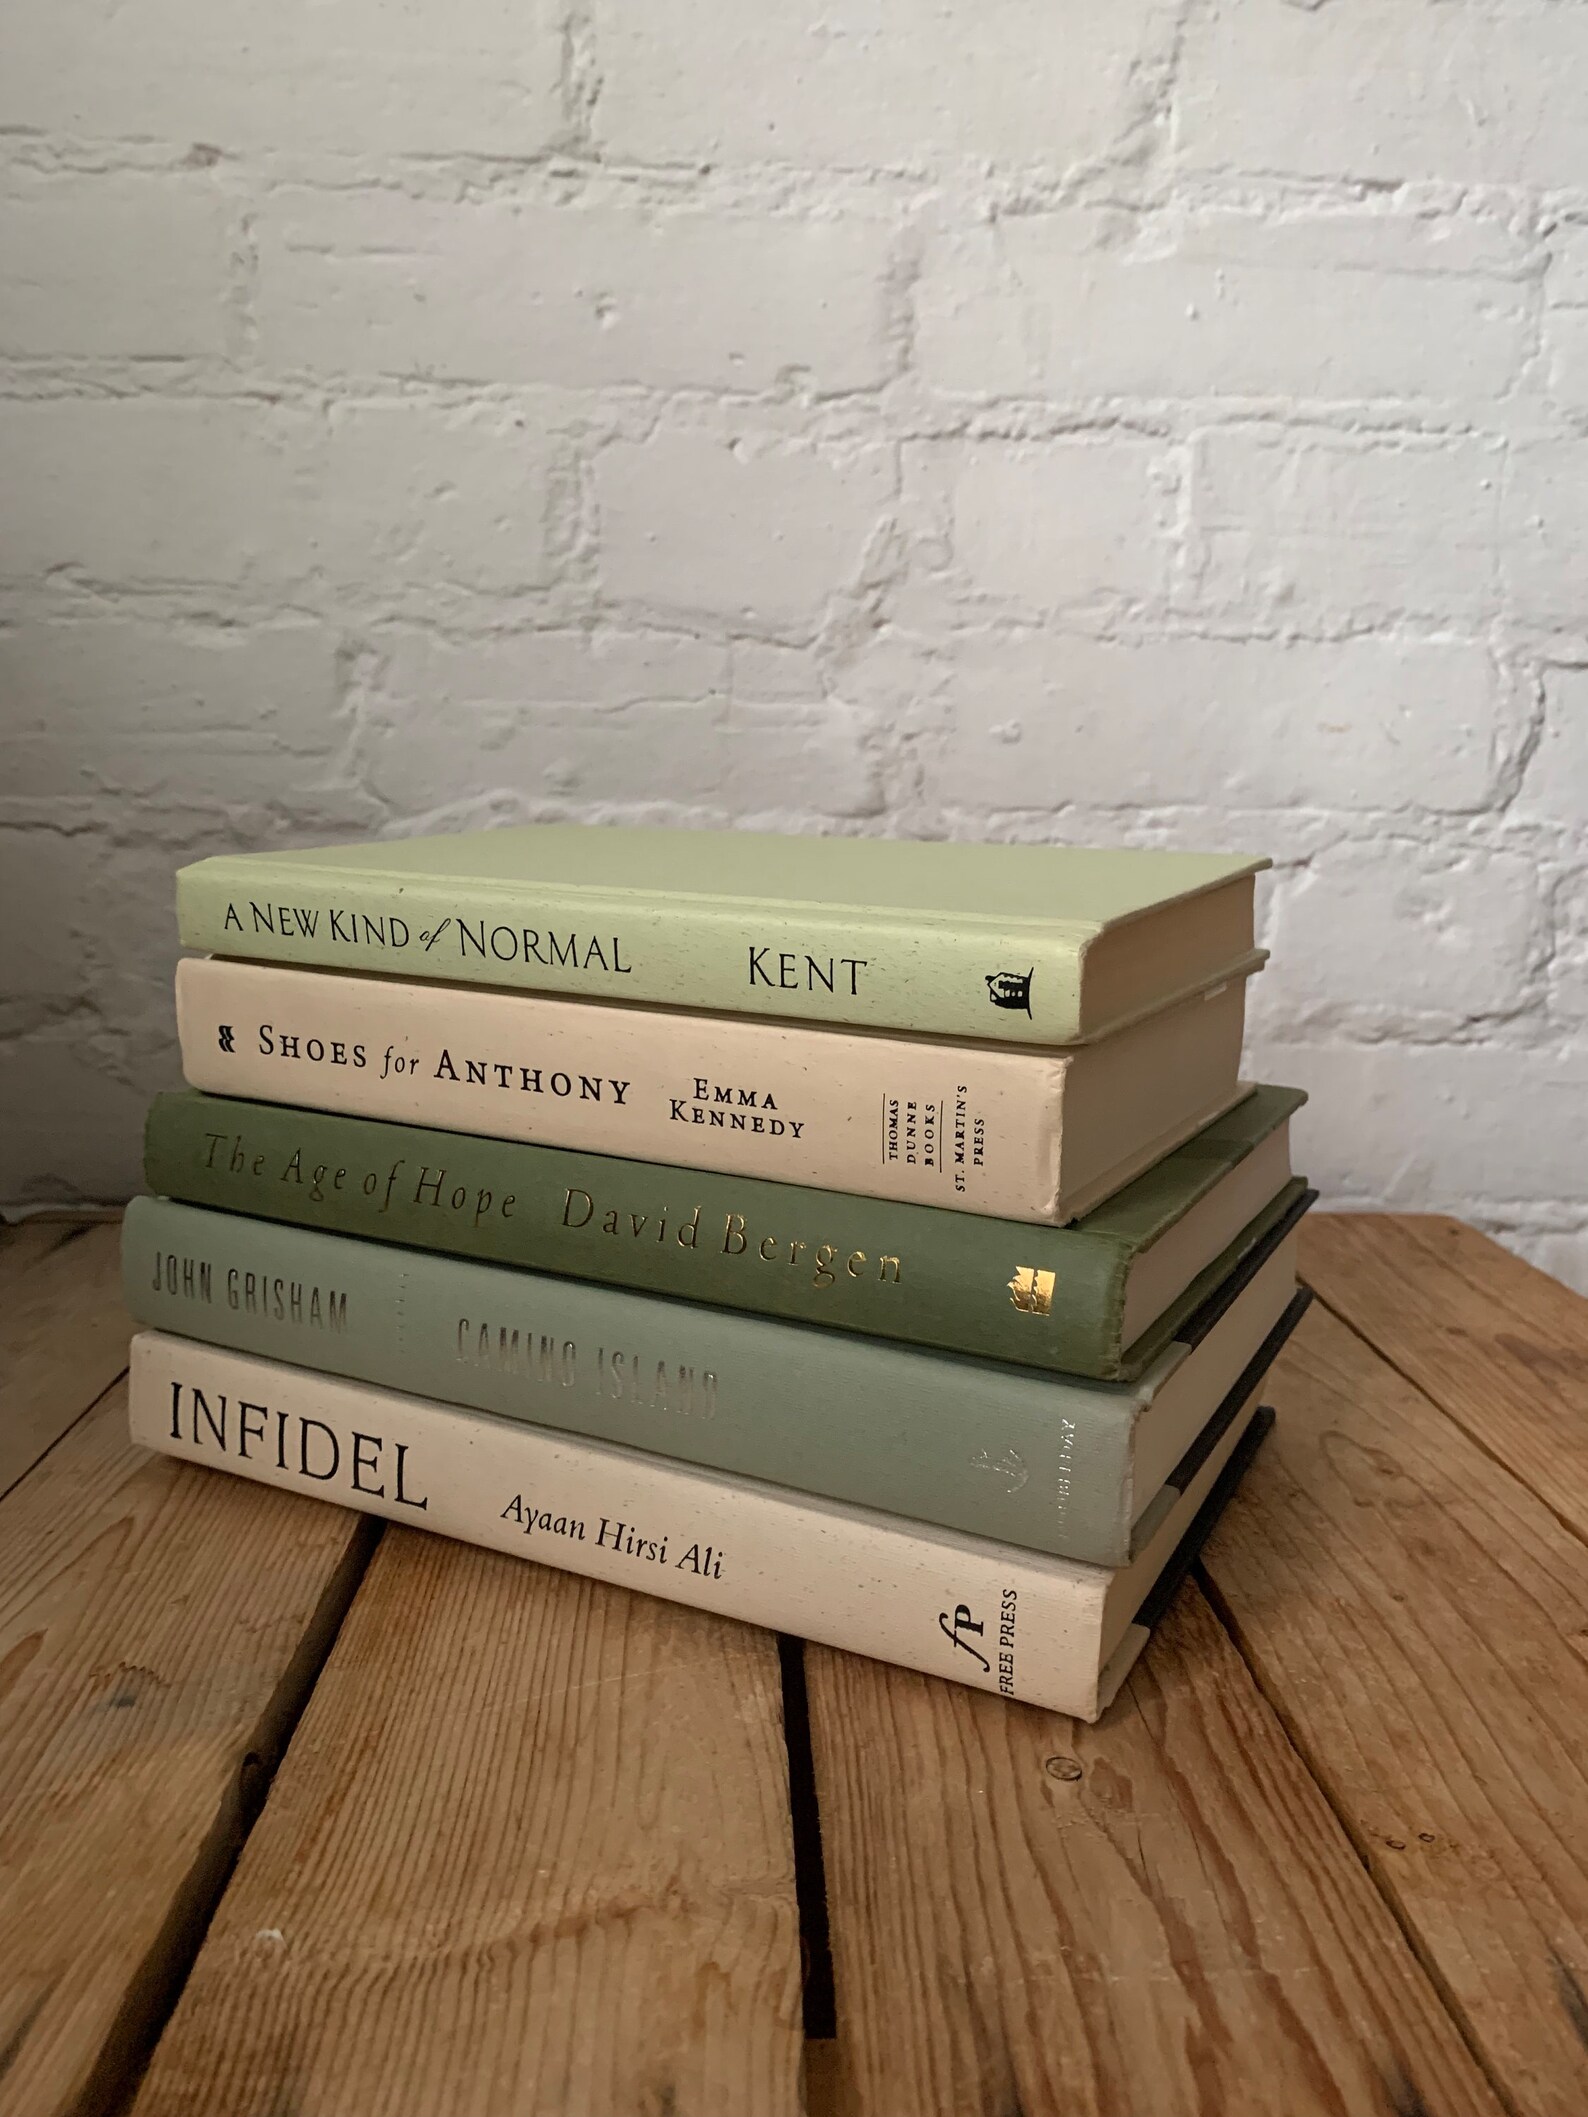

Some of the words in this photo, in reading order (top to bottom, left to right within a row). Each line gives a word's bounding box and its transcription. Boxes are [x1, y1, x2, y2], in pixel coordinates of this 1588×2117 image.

[224, 903, 243, 932] A
[249, 902, 319, 938] NEW
[330, 909, 410, 947] KIND
[419, 918, 451, 952] of
[456, 918, 632, 973] NORMAL
[748, 946, 868, 995] KENT
[258, 1024, 367, 1068] SHOES
[380, 1045, 419, 1079] for
[434, 1049, 631, 1105] ANTHONY
[692, 1077, 779, 1111] EMMA
[669, 1099, 805, 1140] KENNEDY
[888, 1099, 899, 1161] THOMAS
[906, 1101, 917, 1165] DUNNE
[924, 1104, 936, 1167] BOOKS
[954, 1085, 968, 1165] MARTIN'S
[973, 1118, 985, 1167] PRESS
[205, 1133, 265, 1176] The
[280, 1146, 347, 1201] Age
[363, 1160, 405, 1214] of
[413, 1166, 516, 1228] Hope
[954, 1170, 966, 1193] ST.
[562, 1188, 702, 1249] David
[720, 1212, 902, 1289] Bergen
[152, 1251, 212, 1304] JOHN
[228, 1268, 348, 1333] GRISHAM
[170, 1382, 428, 1511] INFIDEL
[500, 1494, 585, 1541] Ayaan
[595, 1517, 668, 1564] Hirsi
[675, 1543, 723, 1580] Ali
[1000, 1588, 1018, 1649] PRESS
[999, 1652, 1015, 1697] FREE
